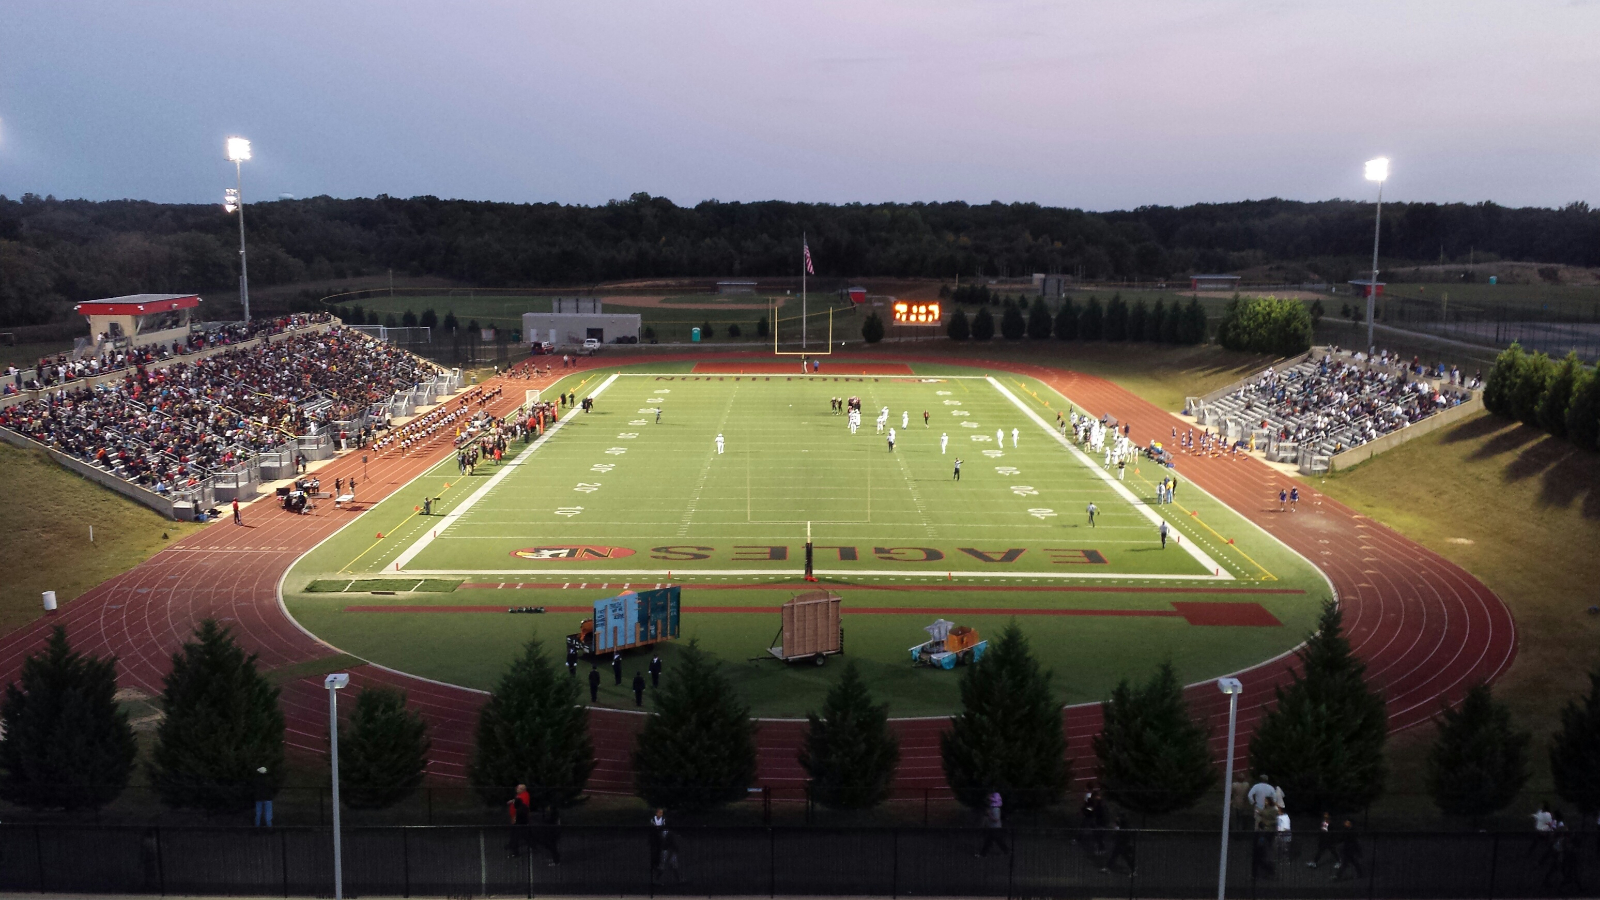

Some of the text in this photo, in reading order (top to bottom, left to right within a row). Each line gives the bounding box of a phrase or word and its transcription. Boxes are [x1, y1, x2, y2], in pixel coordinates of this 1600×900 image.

[590, 463, 616, 471] 30
[573, 482, 602, 491] 20
[1010, 485, 1039, 495] 20
[554, 506, 584, 515] 10
[1027, 508, 1058, 517] 10
[650, 546, 1109, 565] EAGLES
